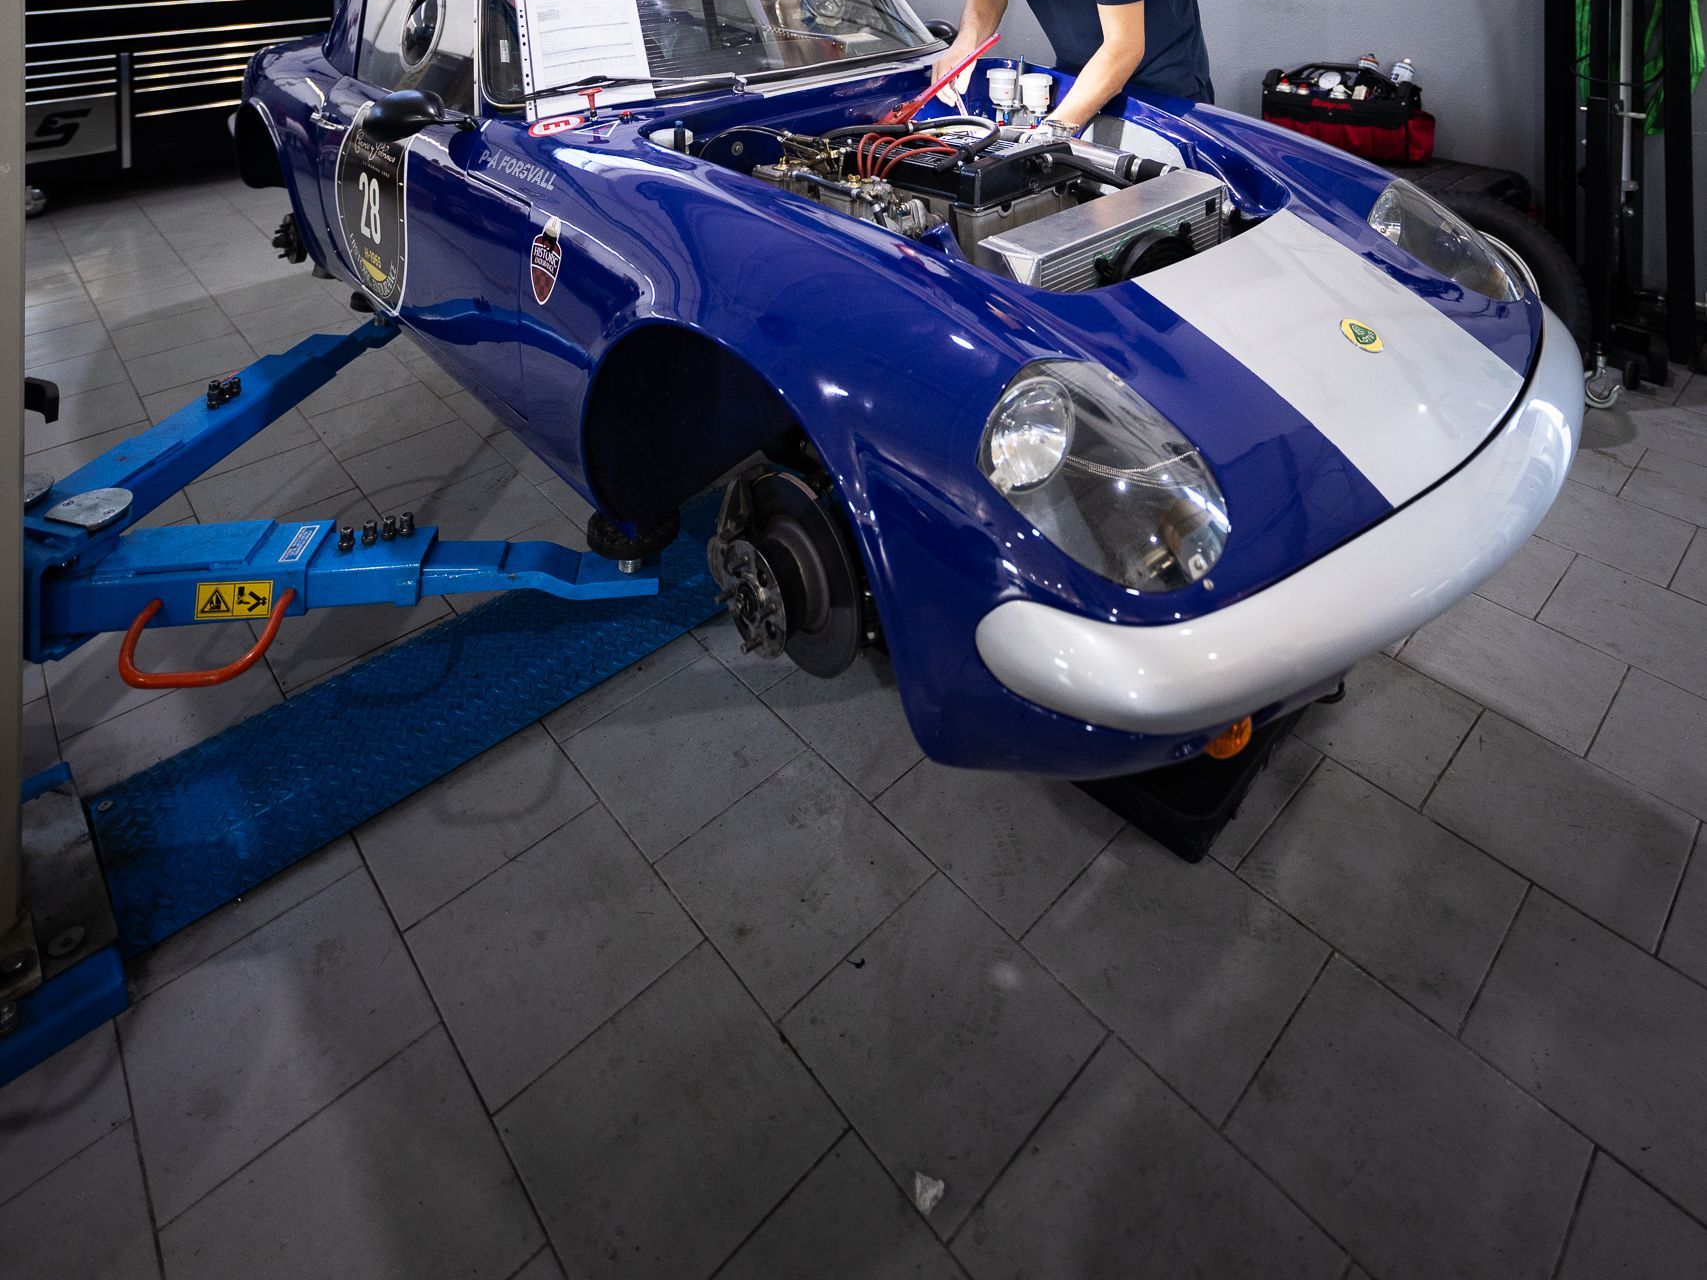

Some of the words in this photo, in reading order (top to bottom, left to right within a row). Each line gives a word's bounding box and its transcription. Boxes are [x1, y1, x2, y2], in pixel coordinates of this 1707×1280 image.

[543, 119, 571, 131] E
[498, 155, 557, 191] FORSVALL
[359, 172, 381, 244] 28
[534, 246, 558, 268] HISTORIC
